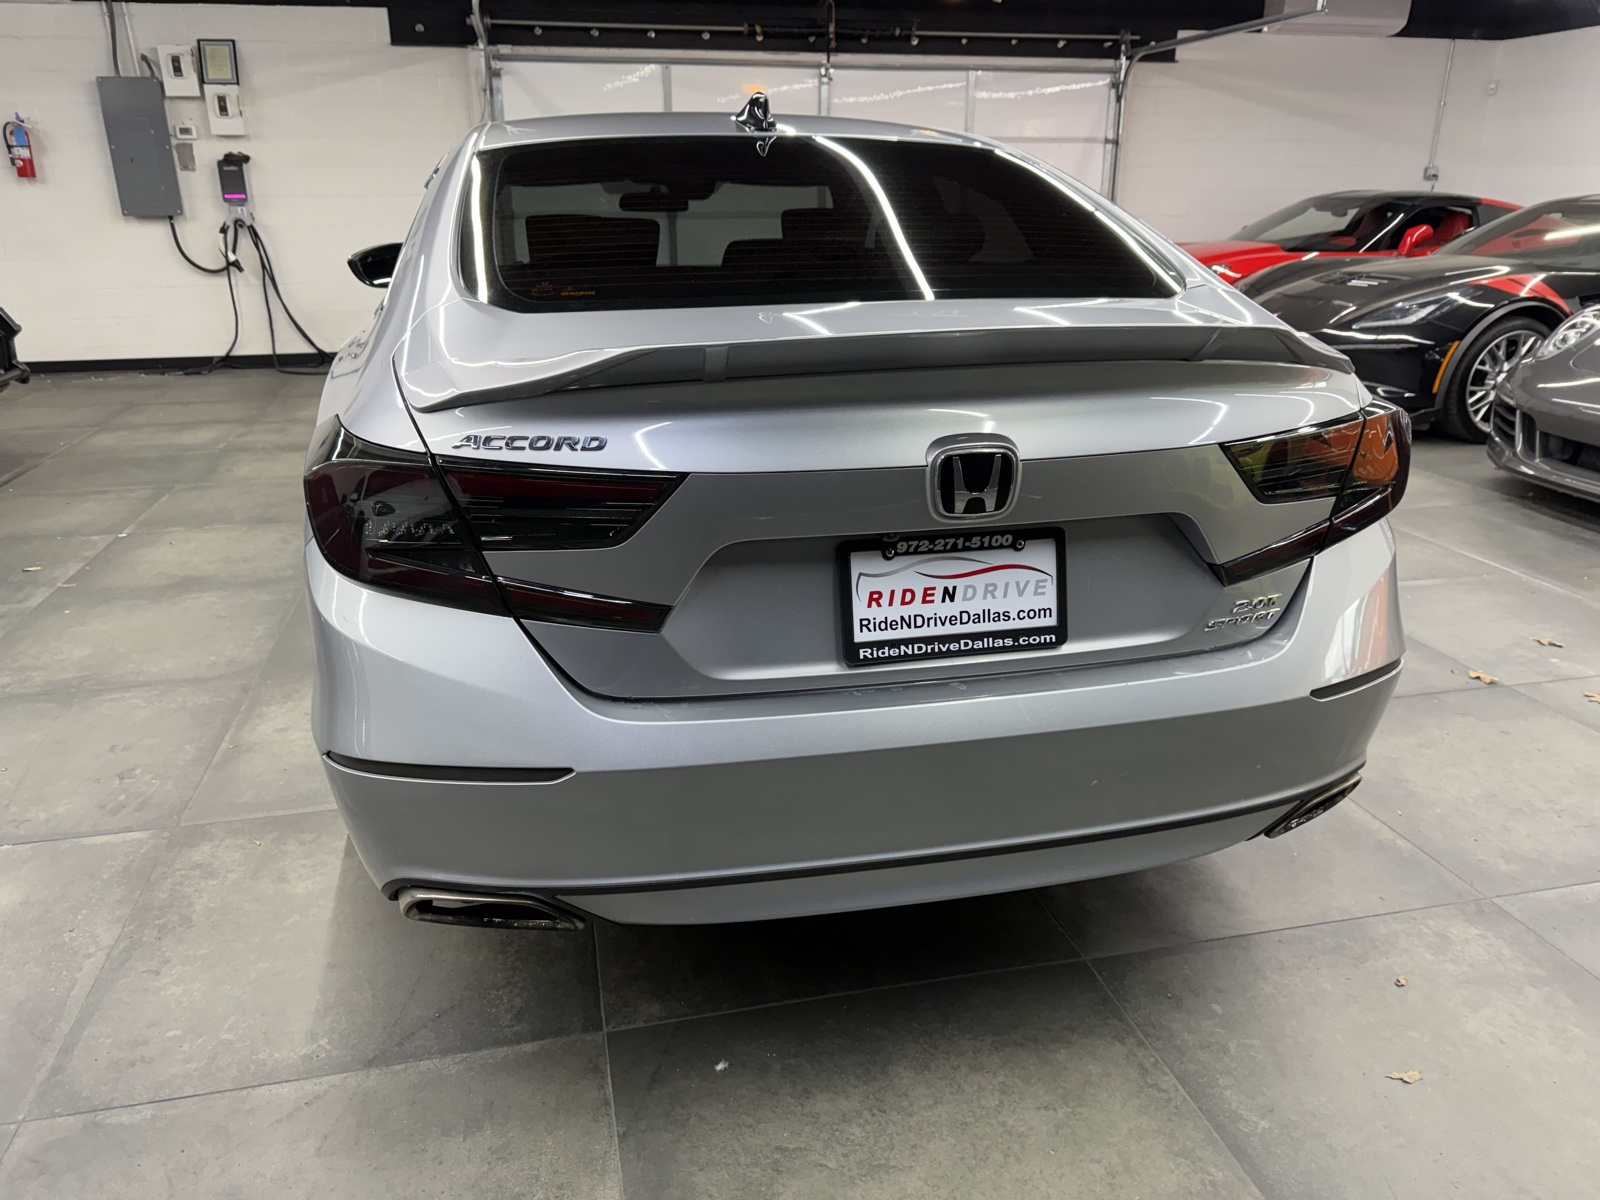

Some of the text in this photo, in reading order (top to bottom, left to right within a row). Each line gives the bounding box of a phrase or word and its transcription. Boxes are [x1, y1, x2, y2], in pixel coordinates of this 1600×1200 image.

[452, 434, 608, 451] ACCORD
[896, 534, 1013, 553] 972-271-5100
[859, 607, 1052, 633] RideNDriveDallas.com
[1204, 608, 1281, 631] SPORT
[859, 633, 1056, 659] RideNDriveDallas.com
